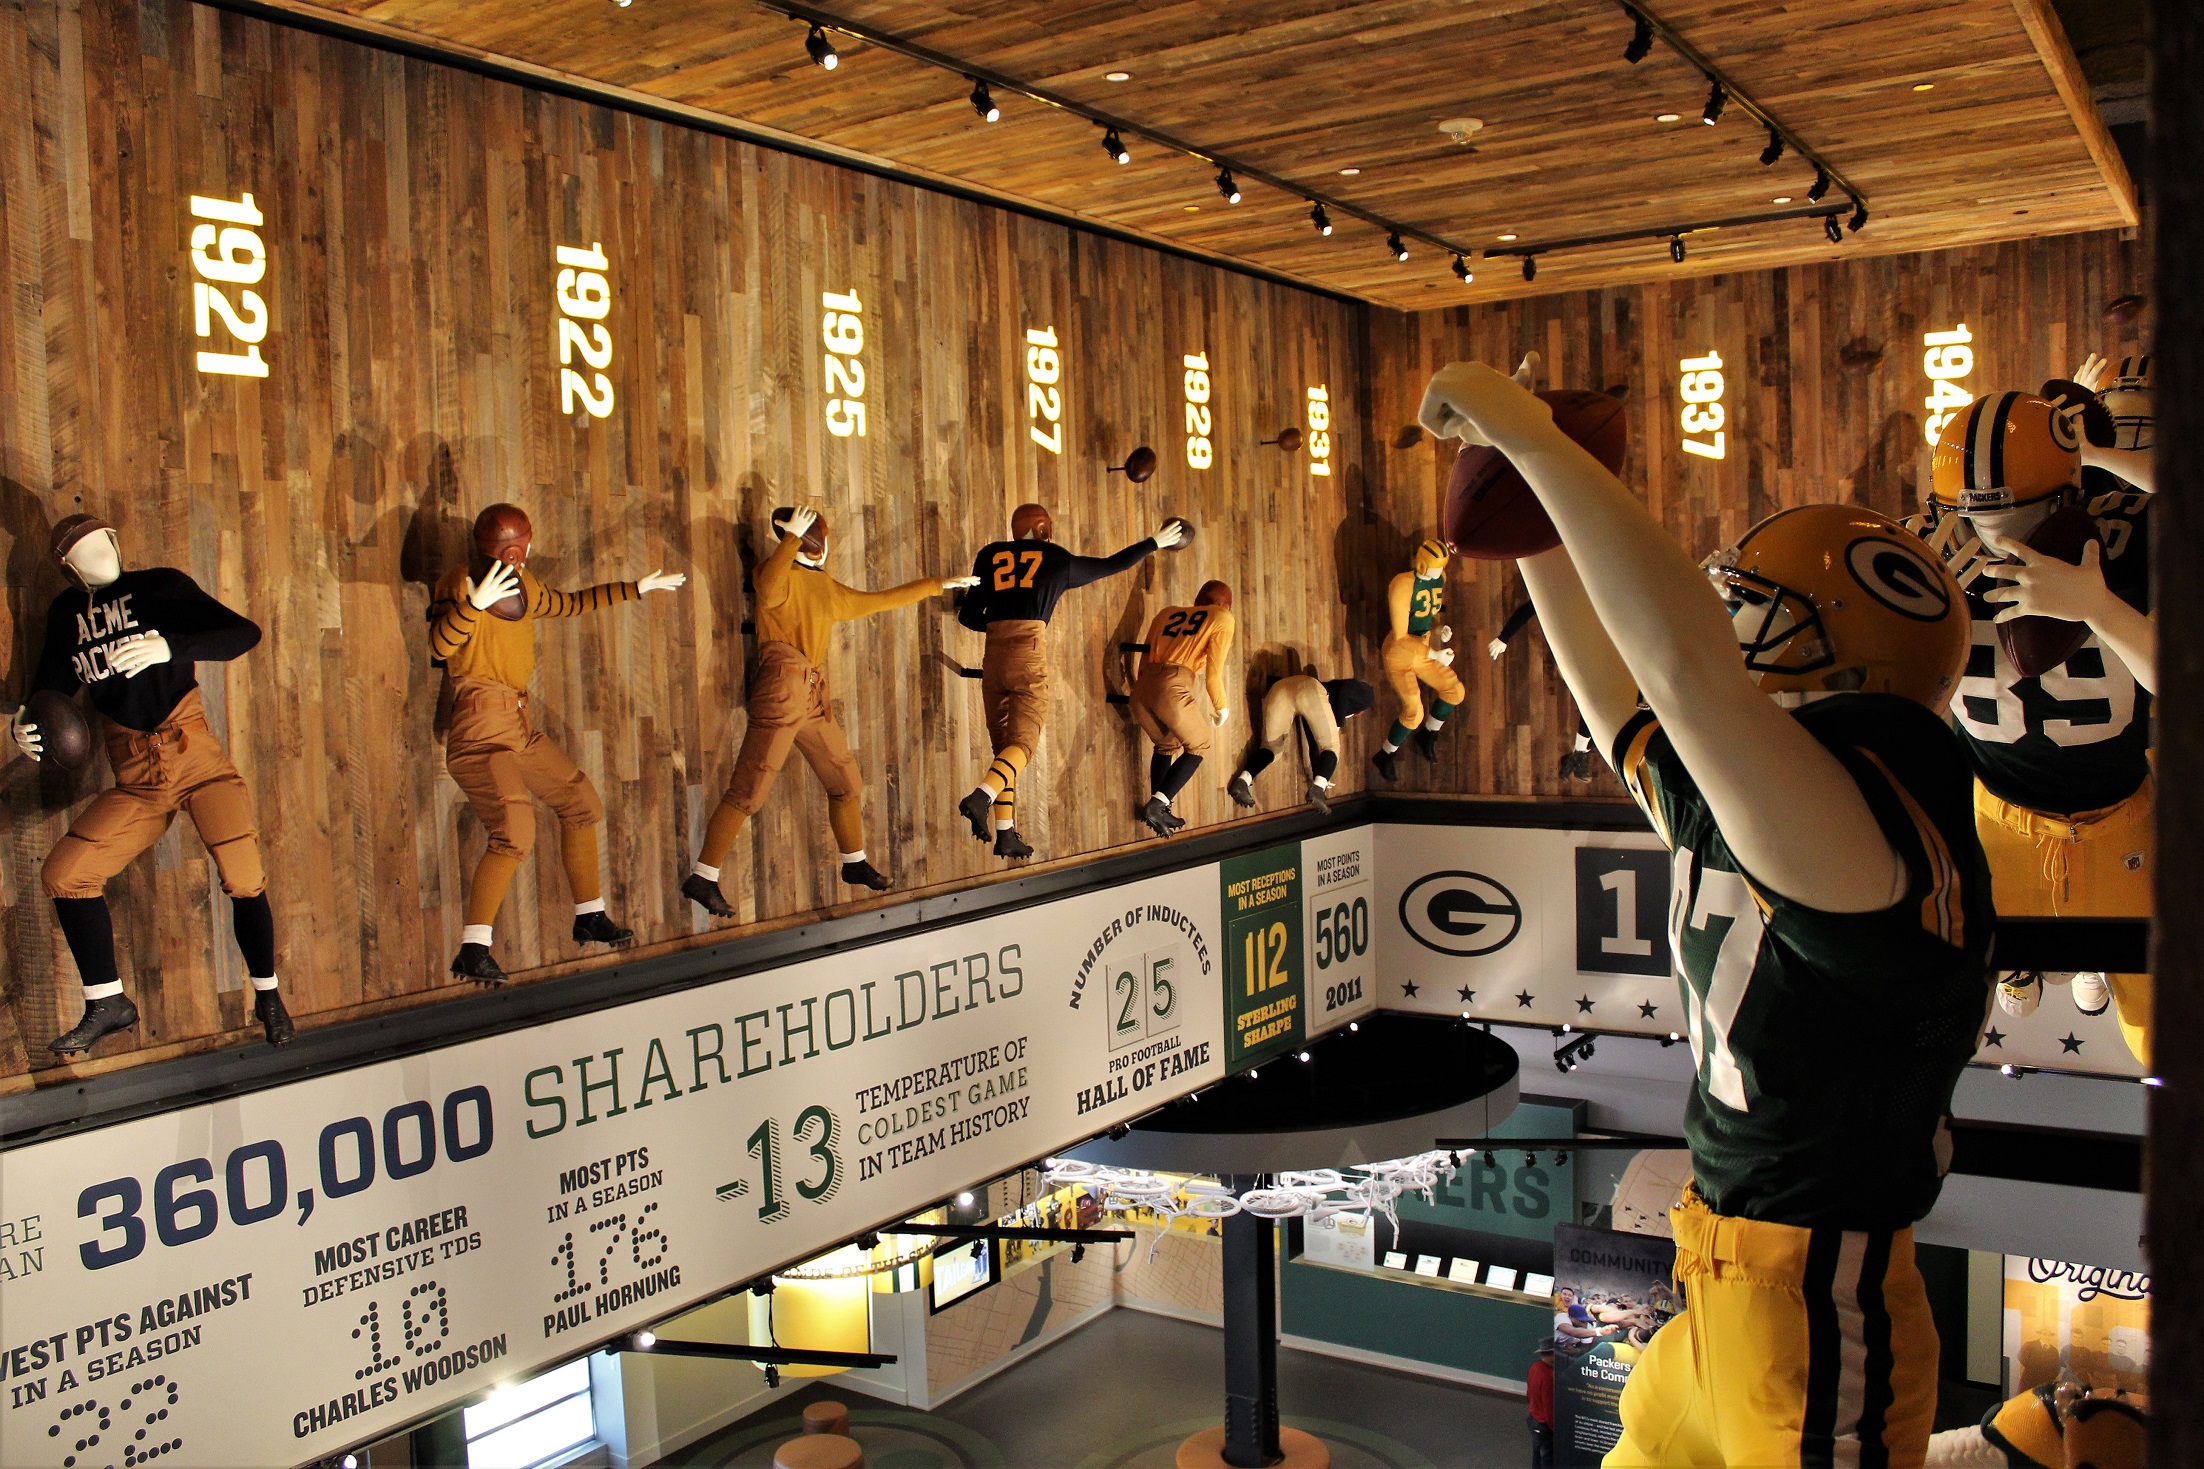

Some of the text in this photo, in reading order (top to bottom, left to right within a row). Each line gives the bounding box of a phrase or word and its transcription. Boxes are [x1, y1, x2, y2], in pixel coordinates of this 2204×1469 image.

[190, 193, 269, 378] 1921
[556, 242, 615, 418] 1922
[822, 288, 866, 437] 1925
[1026, 326, 1061, 454] 1927
[1183, 351, 1213, 469] 1929
[1679, 350, 1725, 460] 1937
[1307, 383, 1331, 476] 1931
[1969, 491, 2001, 503] PACKERS
[992, 550, 1043, 591] 27
[1415, 587, 1443, 618] 35
[76, 593, 139, 645] ACME
[1162, 610, 1208, 638] 29
[1228, 867, 1296, 898] MOST RECEPTIONS
[1238, 884, 1287, 911] IN A SEASON
[1317, 850, 1360, 872] MOST POINTS
[1317, 864, 1360, 888] IN A SEASON
[1316, 896, 1369, 970] 560
[1598, 868, 1653, 957] 1
[1069, 904, 1212, 1010] NUMBER OF INDUCTEES
[1245, 921, 1289, 997] 112
[1326, 976, 1362, 1012] 2011
[1115, 956, 1178, 1037] 25
[1237, 995, 1297, 1032] STERLING
[1243, 1015, 1292, 1048] SHARPE
[855, 1036, 1028, 1114] TEMPERATURE OF
[1076, 1041, 1210, 1116] HALL OF FAME
[1108, 1035, 1181, 1074] PRO FOOTBALL
[76, 943, 1023, 1272] 360,000 SHAREHOLDERS
[858, 1066, 1029, 1146] COLDEST GAME
[859, 1095, 1031, 1182] IN TEAM HISTORY
[547, 1169, 663, 1224] IN A SEASON
[559, 1146, 649, 1195] MOST PTS
[716, 1104, 844, 1225] -13
[303, 1231, 482, 1308] DEFENSIVE TDS
[314, 1205, 468, 1276] MOST CAREER
[551, 1201, 668, 1303] 176
[871, 1255, 905, 1274] THE
[1570, 1248, 1672, 1277] COMMUNITY
[76, 1312, 133, 1356] PTS
[139, 1272, 253, 1335] AGAINST
[351, 1280, 449, 1380] 10
[543, 1265, 681, 1338] PAUL HORNUNG
[11, 1324, 201, 1410] IN A SEASON
[293, 1333, 507, 1439] CHARLES WOODSON
[1581, 1366, 1598, 1378] the
[1589, 1355, 1631, 1371] Packers
[48, 1374, 183, 1469] 22
